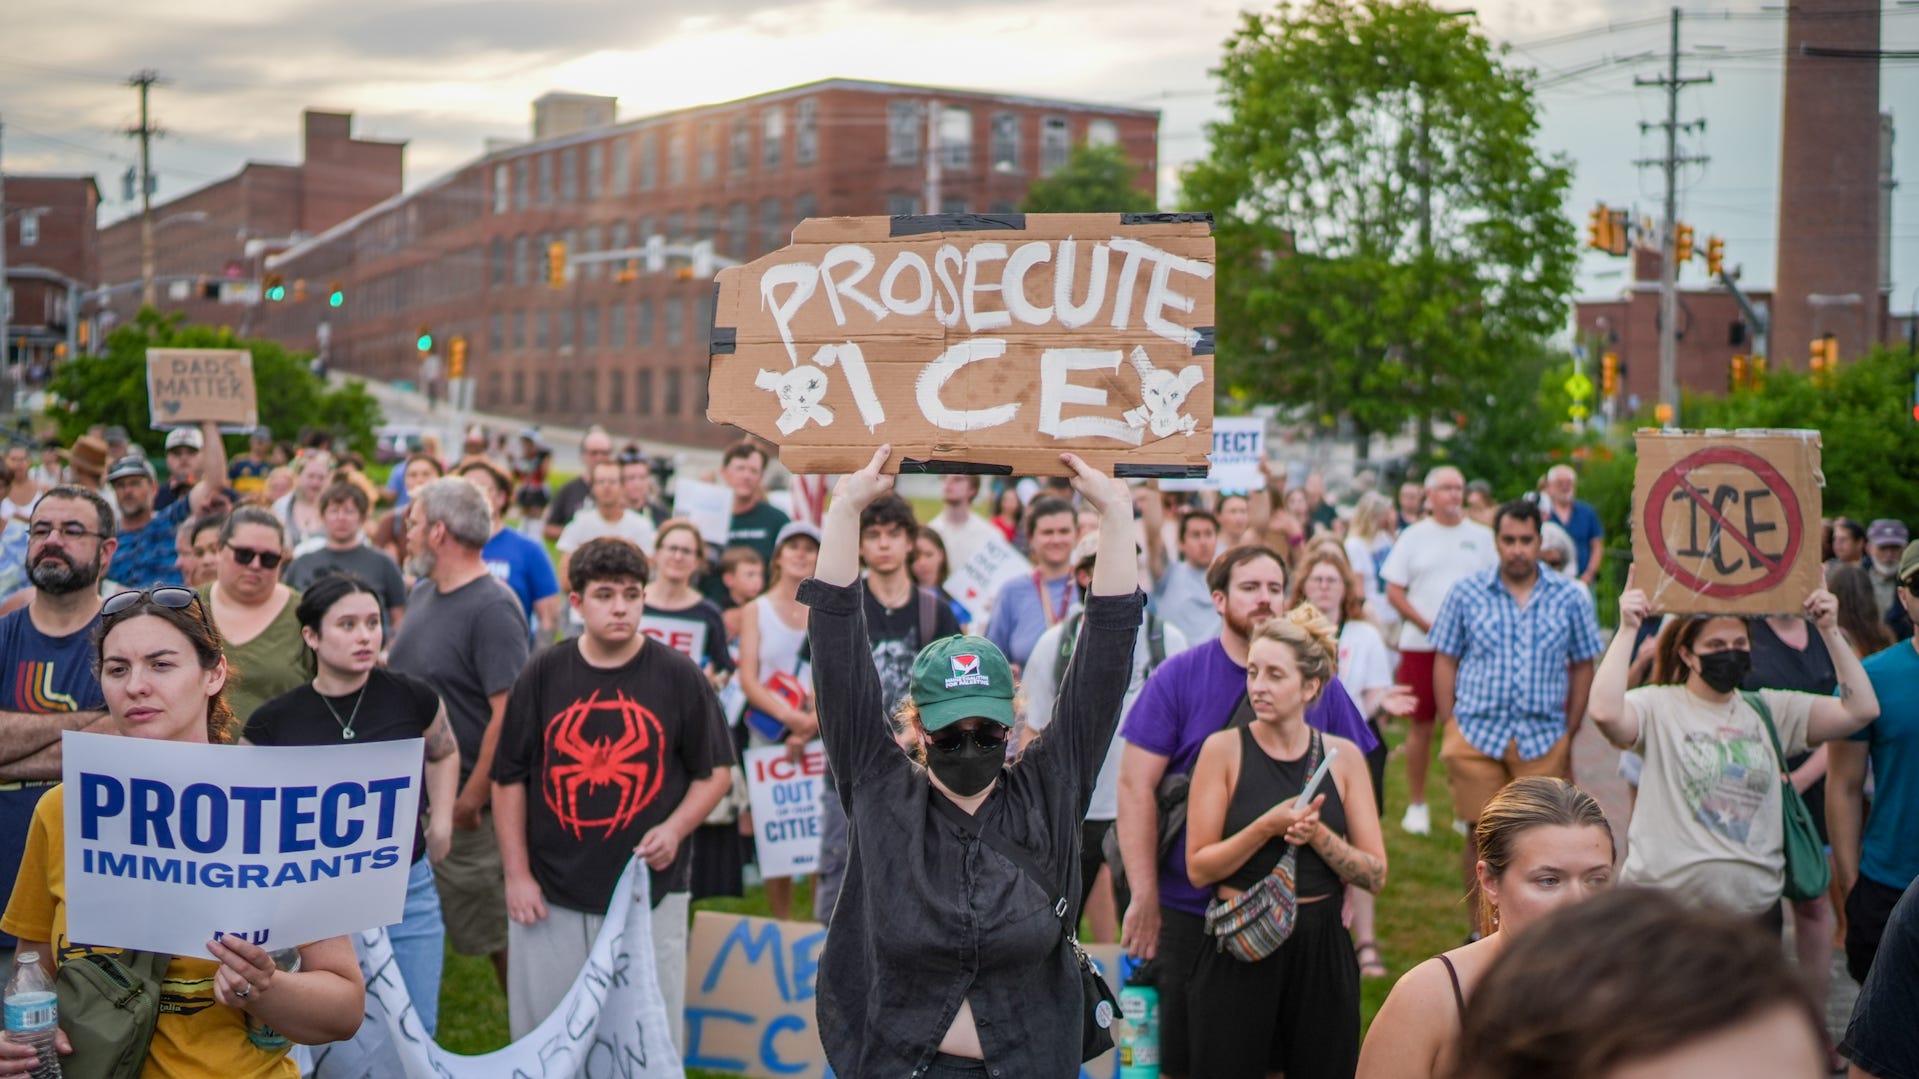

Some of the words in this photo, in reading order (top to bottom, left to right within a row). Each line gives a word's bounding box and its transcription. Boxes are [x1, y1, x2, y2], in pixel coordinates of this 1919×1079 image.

[760, 236, 1214, 367] PROSECUTE
[156, 377, 245, 399] MATTER
[812, 338, 1144, 446] ICE
[1672, 484, 1783, 575] ICE
[756, 752, 826, 782] ICE
[80, 772, 411, 855] PROTECT
[772, 780, 814, 806] OUT
[765, 815, 821, 843] CITIE
[83, 846, 400, 889] IMMIGRANTS
